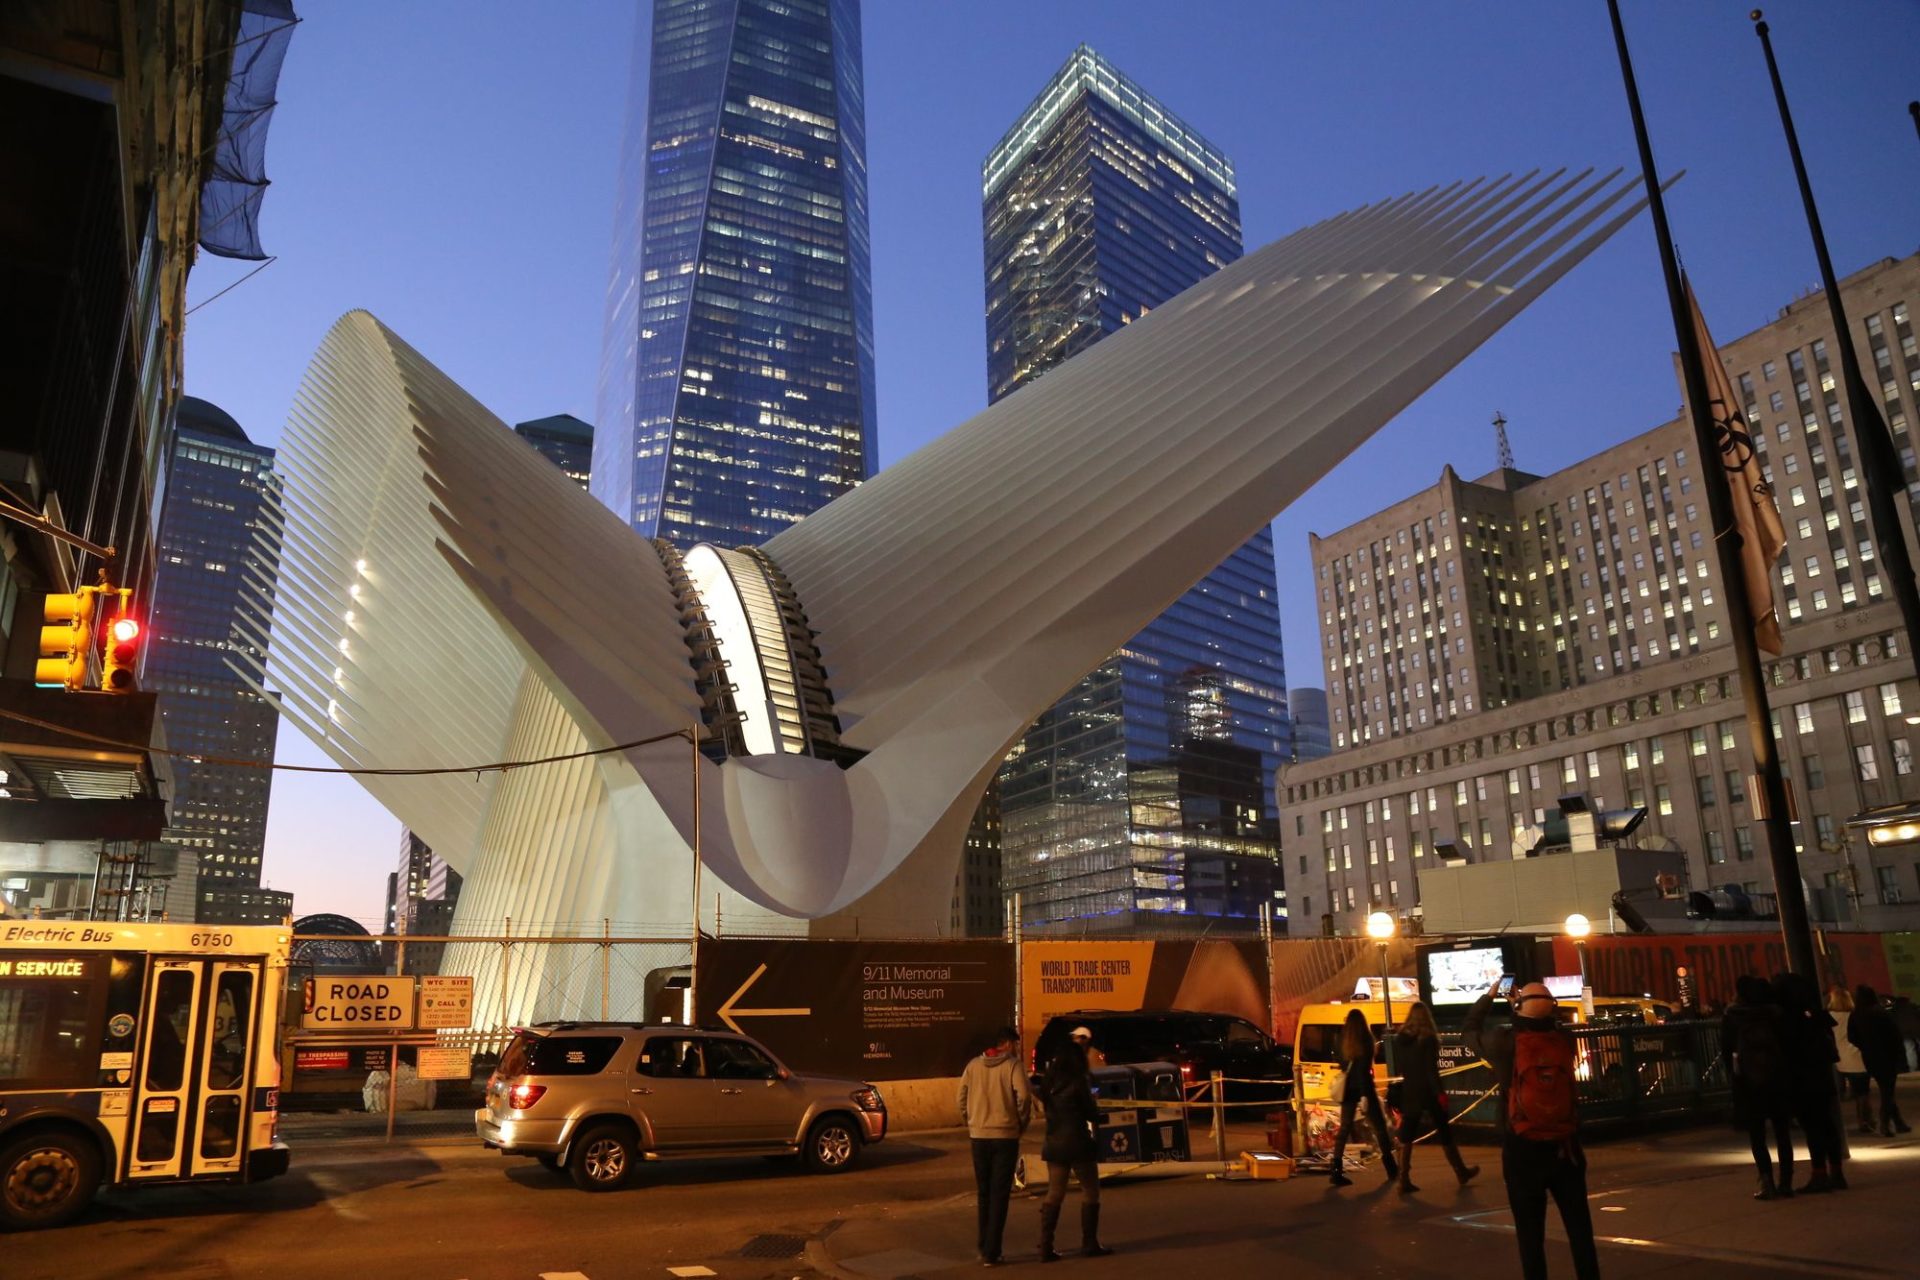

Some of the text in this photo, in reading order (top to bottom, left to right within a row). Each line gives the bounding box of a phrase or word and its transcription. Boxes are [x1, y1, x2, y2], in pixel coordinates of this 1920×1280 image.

[5, 926, 113, 942] Electric Bus
[191, 934, 233, 947] 6750
[16, 961, 83, 976] SERVICE
[863, 966, 951, 980] 9/11 Memorial
[1041, 960, 1131, 976] WORLD TRADE CENTER
[331, 984, 389, 999] ROAD
[863, 986, 944, 1000] and Museum
[1041, 977, 1114, 994] TRANSPORTATION
[315, 1006, 401, 1021] CLOSED
